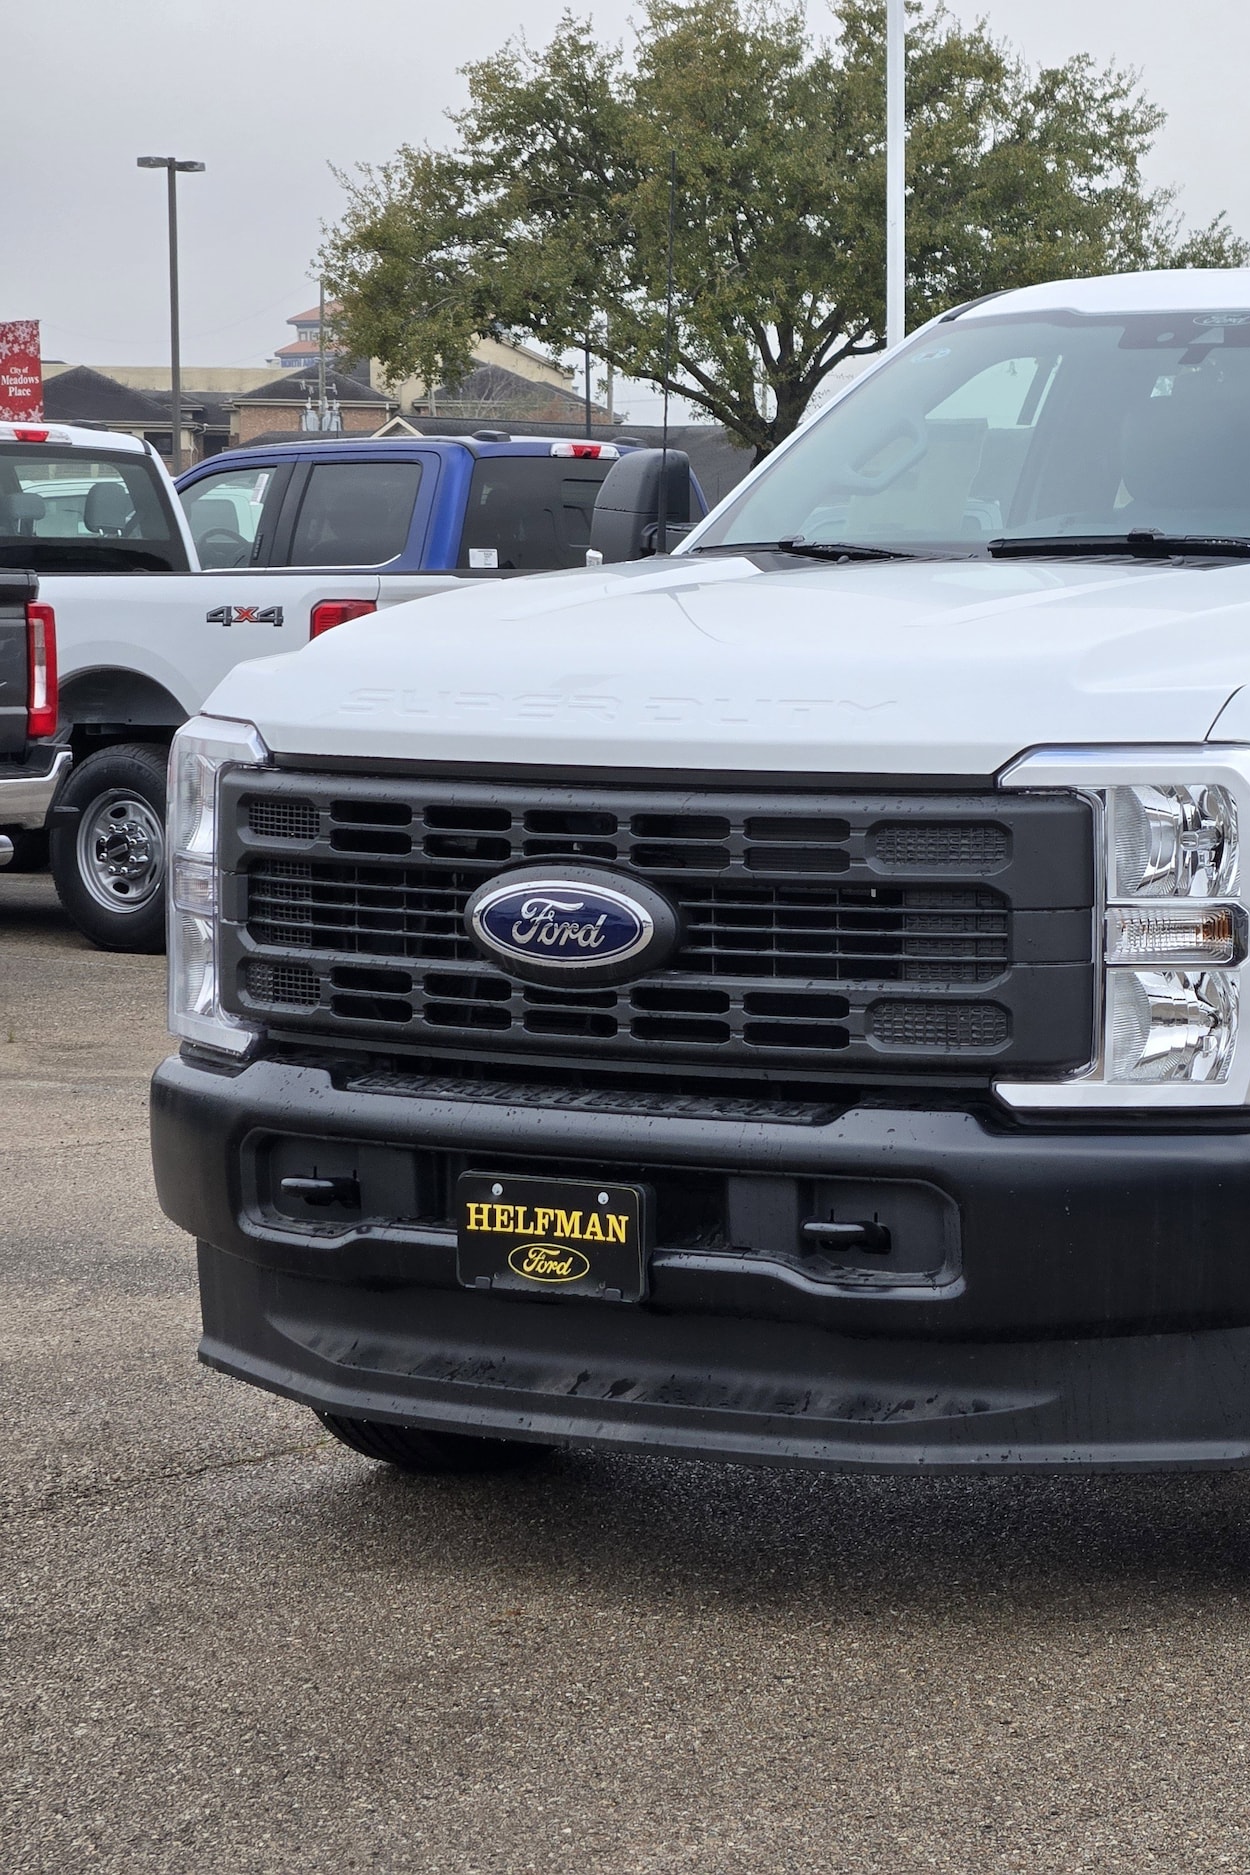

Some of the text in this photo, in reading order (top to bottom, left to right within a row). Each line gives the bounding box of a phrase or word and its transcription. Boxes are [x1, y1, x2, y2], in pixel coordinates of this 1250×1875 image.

[1203, 314, 1250, 325] Ford
[10, 366, 29, 375] City of
[1, 375, 40, 386] Meadows
[8, 386, 31, 397] Place
[336, 688, 900, 728] SUPER DUTY
[511, 898, 606, 948] Ford
[466, 1203, 629, 1243] HELFMAN
[523, 1247, 574, 1275] Ford
